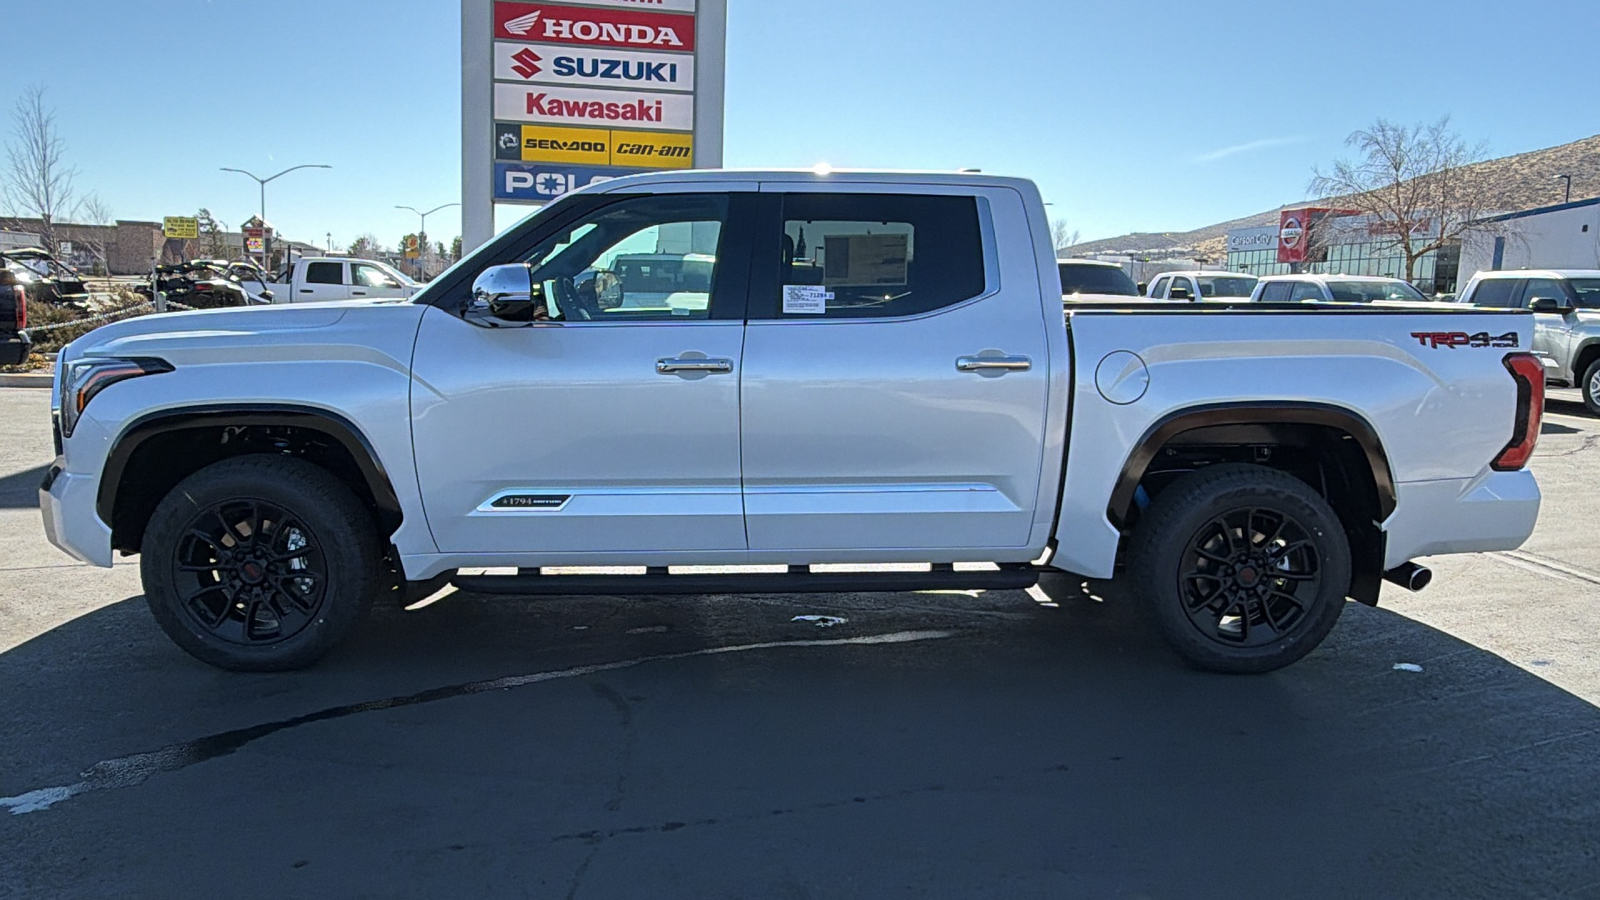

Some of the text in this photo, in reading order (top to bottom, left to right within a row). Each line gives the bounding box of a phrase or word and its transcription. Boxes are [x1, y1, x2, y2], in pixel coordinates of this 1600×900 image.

[542, 18, 684, 46] HONDA
[552, 56, 677, 83] SUZUKI
[526, 92, 663, 122] Kawasaki
[616, 142, 691, 158] can-am
[1256, 234, 1272, 246] City
[1410, 332, 1470, 349] TRD
[509, 497, 532, 505] 1794
